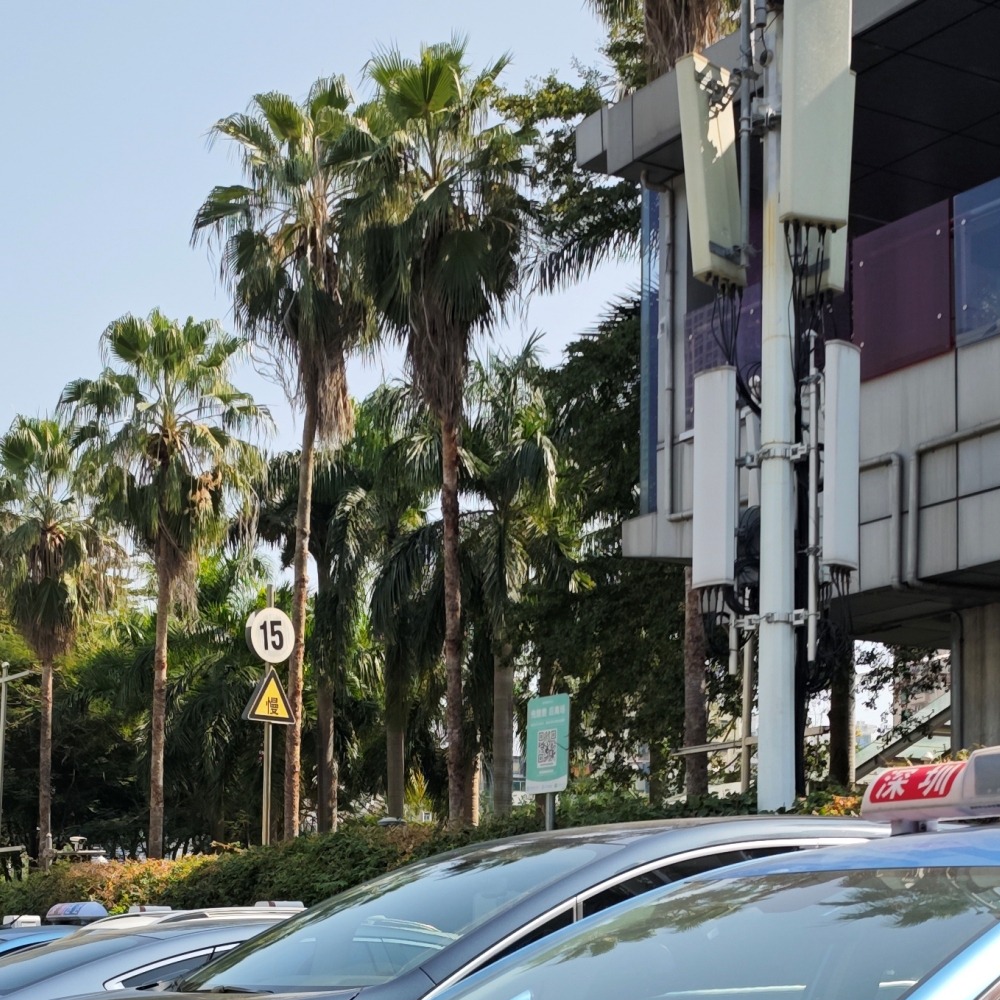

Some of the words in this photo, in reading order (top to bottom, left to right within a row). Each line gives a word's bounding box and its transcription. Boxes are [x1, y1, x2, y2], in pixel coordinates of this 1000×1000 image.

[260, 620, 284, 650] 15
[266, 697, 279, 715] 慢
[875, 762, 957, 800] 深圳
